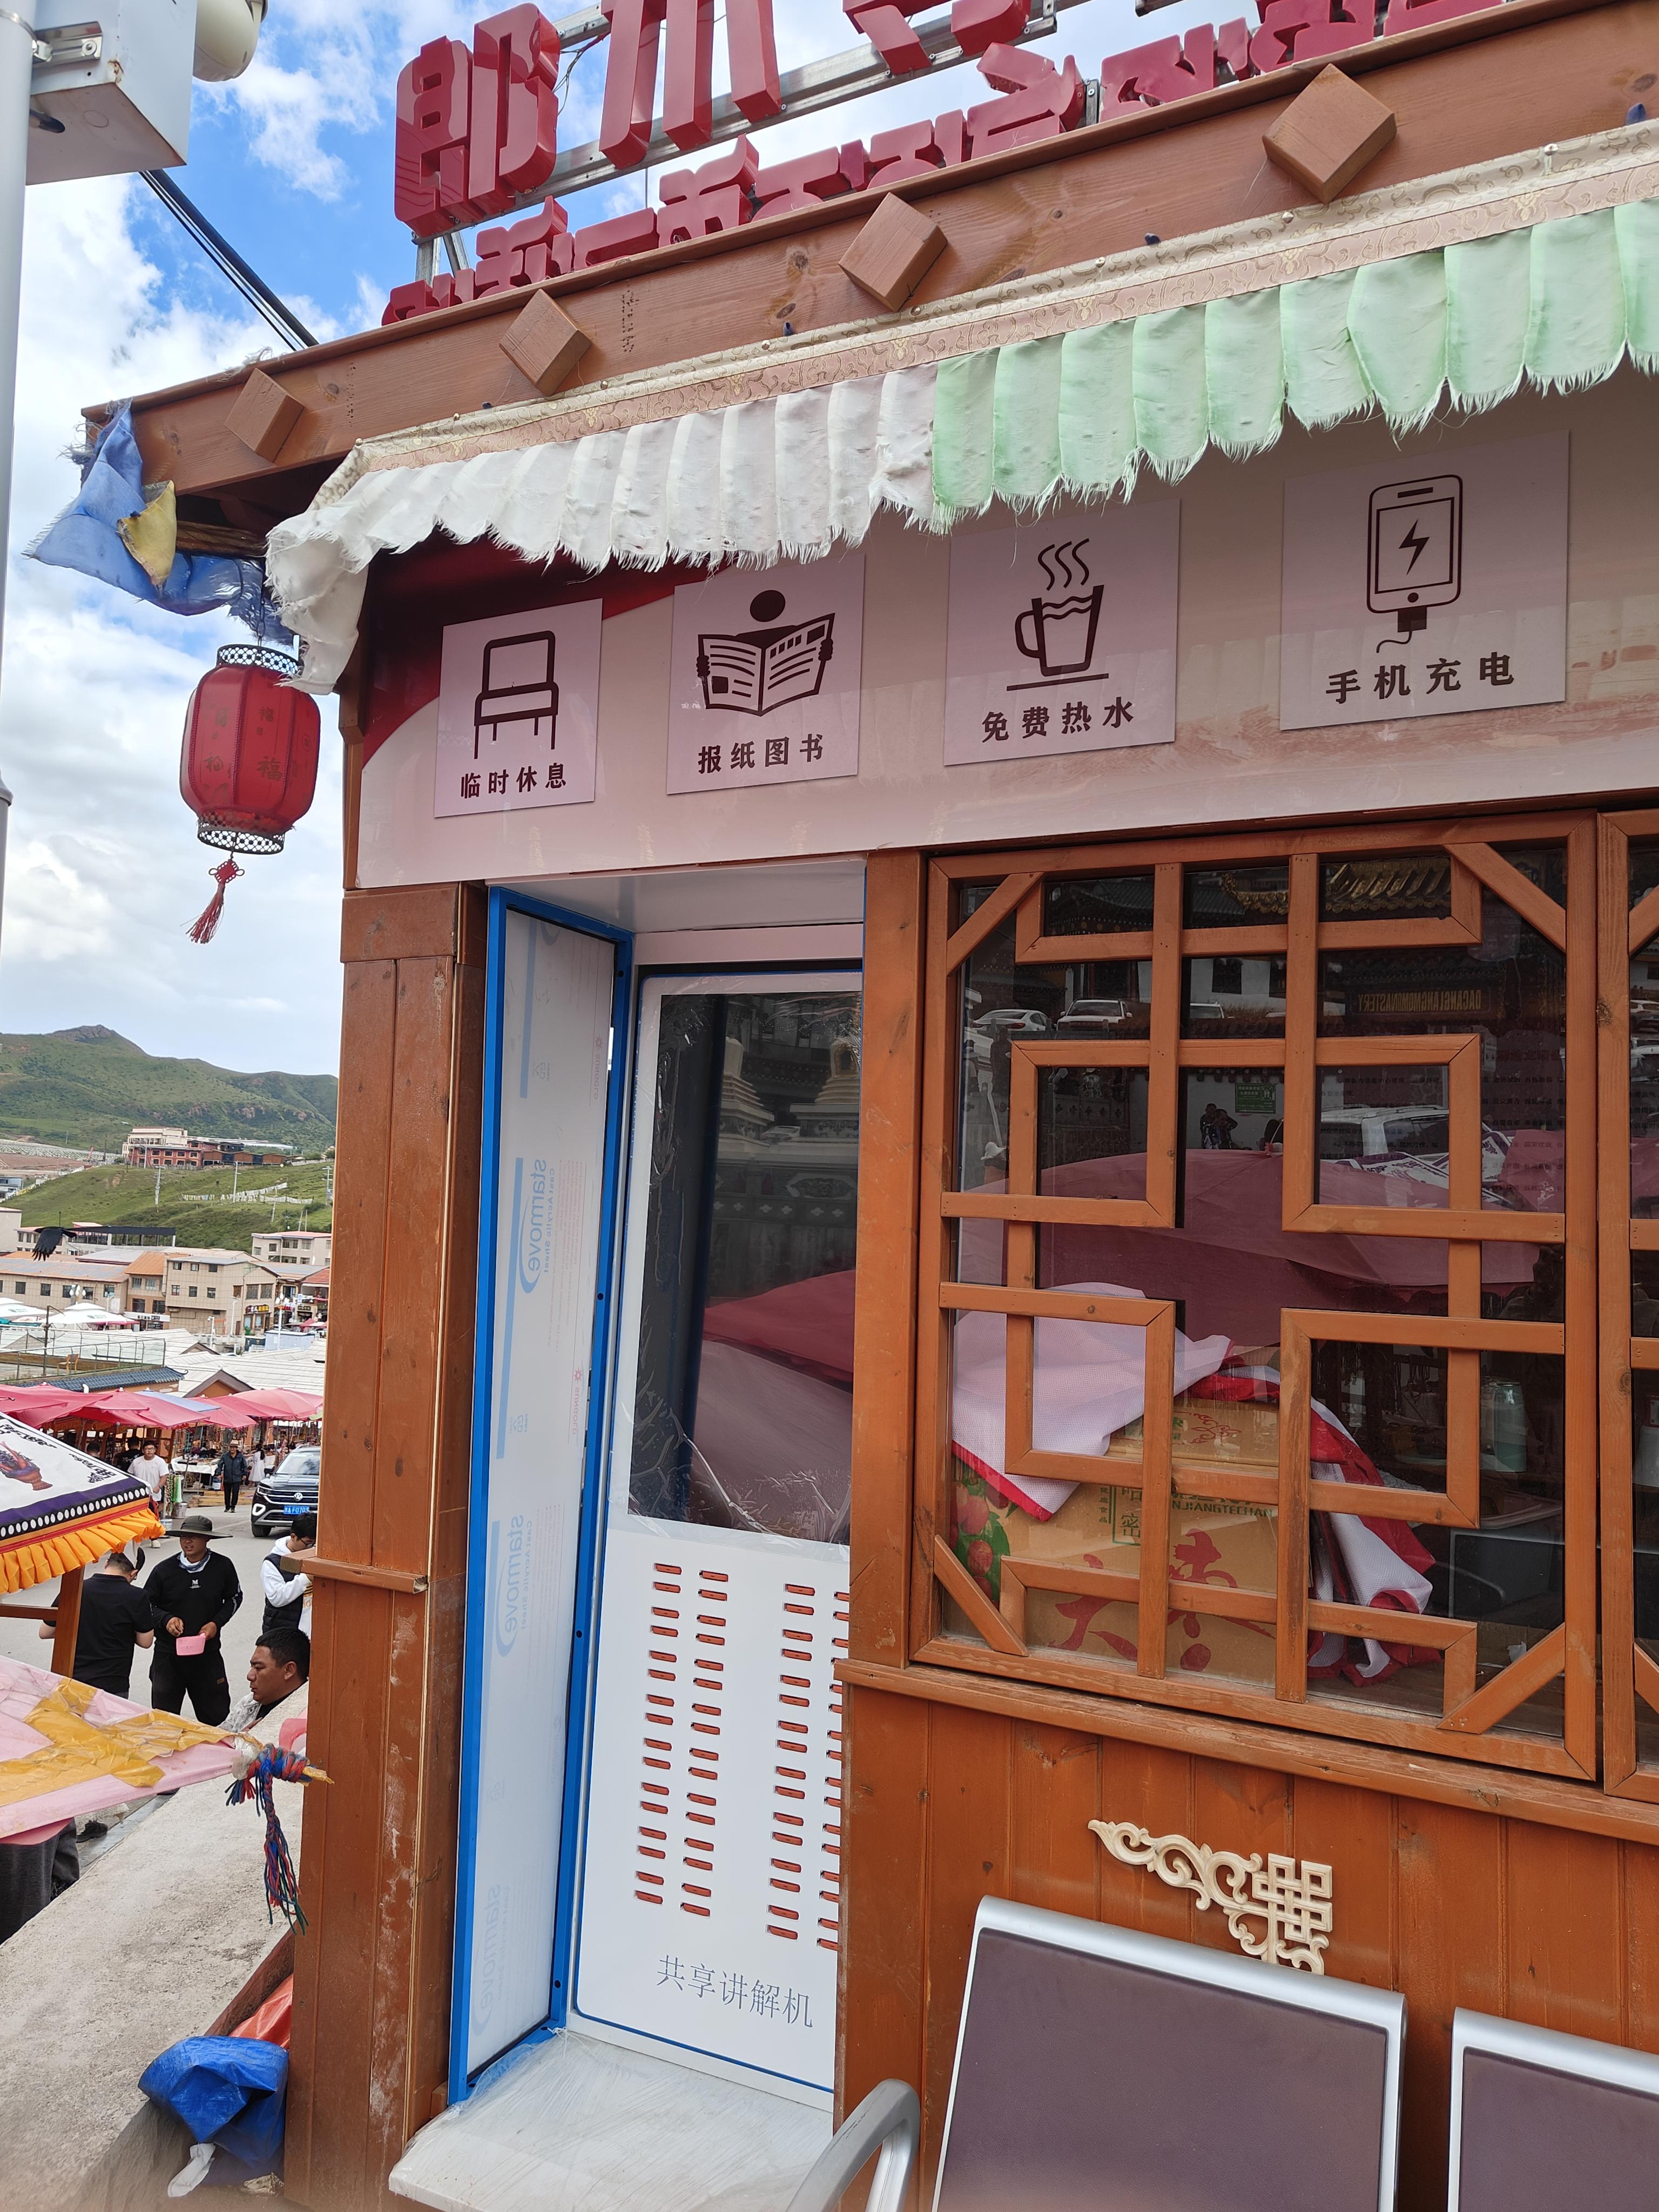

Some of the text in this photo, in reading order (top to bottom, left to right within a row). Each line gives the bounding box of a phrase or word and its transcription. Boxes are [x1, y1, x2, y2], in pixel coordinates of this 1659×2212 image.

[1325, 651, 1514, 704] 手机充电
[981, 696, 1134, 744] 免费热水
[697, 733, 824, 774] 报纸图书
[460, 762, 567, 799] 临时休息
[656, 1954, 813, 2028] 共享讲解机
